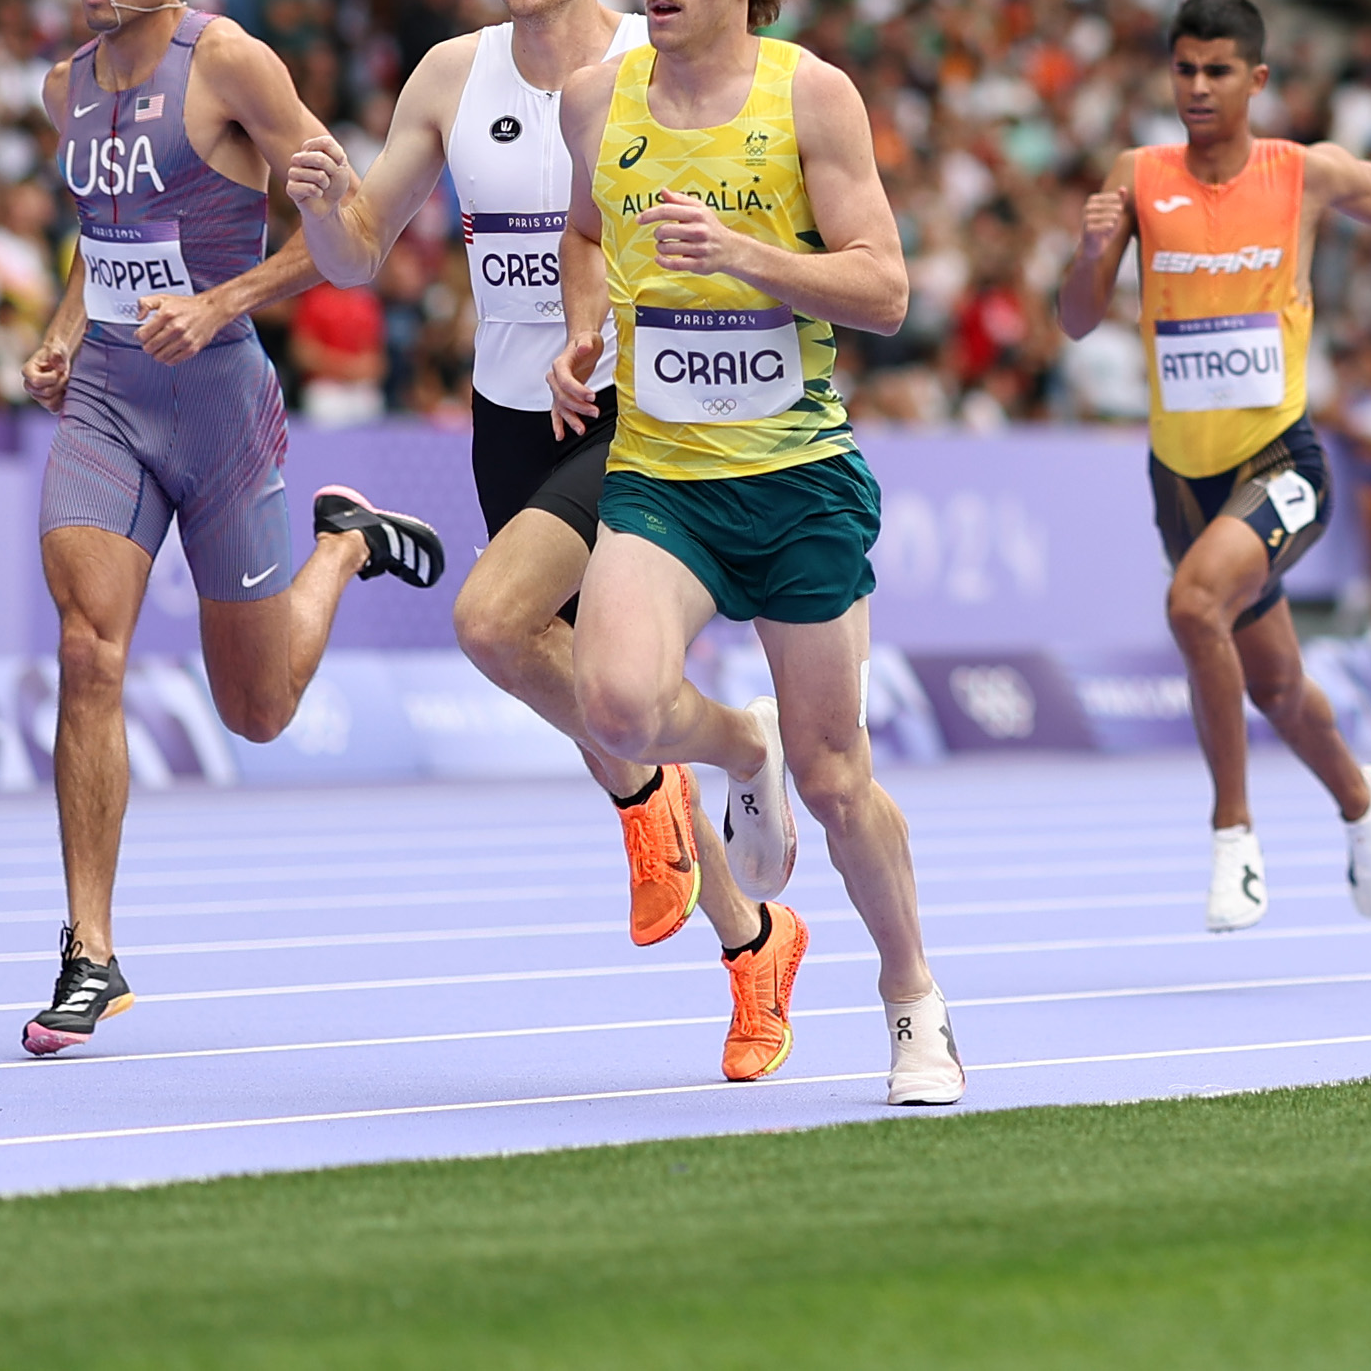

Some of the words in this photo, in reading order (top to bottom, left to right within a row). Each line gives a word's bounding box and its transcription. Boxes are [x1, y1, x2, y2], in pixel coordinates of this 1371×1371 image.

[65, 135, 166, 197] USA
[622, 189, 763, 216] AUALIA
[508, 217, 541, 228] PARIS
[544, 215, 568, 227] 20
[85, 254, 185, 291] HOPPEL
[1151, 245, 1284, 275] ESPAÑA
[674, 314, 713, 326] PARIS
[718, 314, 756, 325] 2024
[654, 349, 785, 385] CRAIG
[1162, 346, 1280, 380] ATTAOUI
